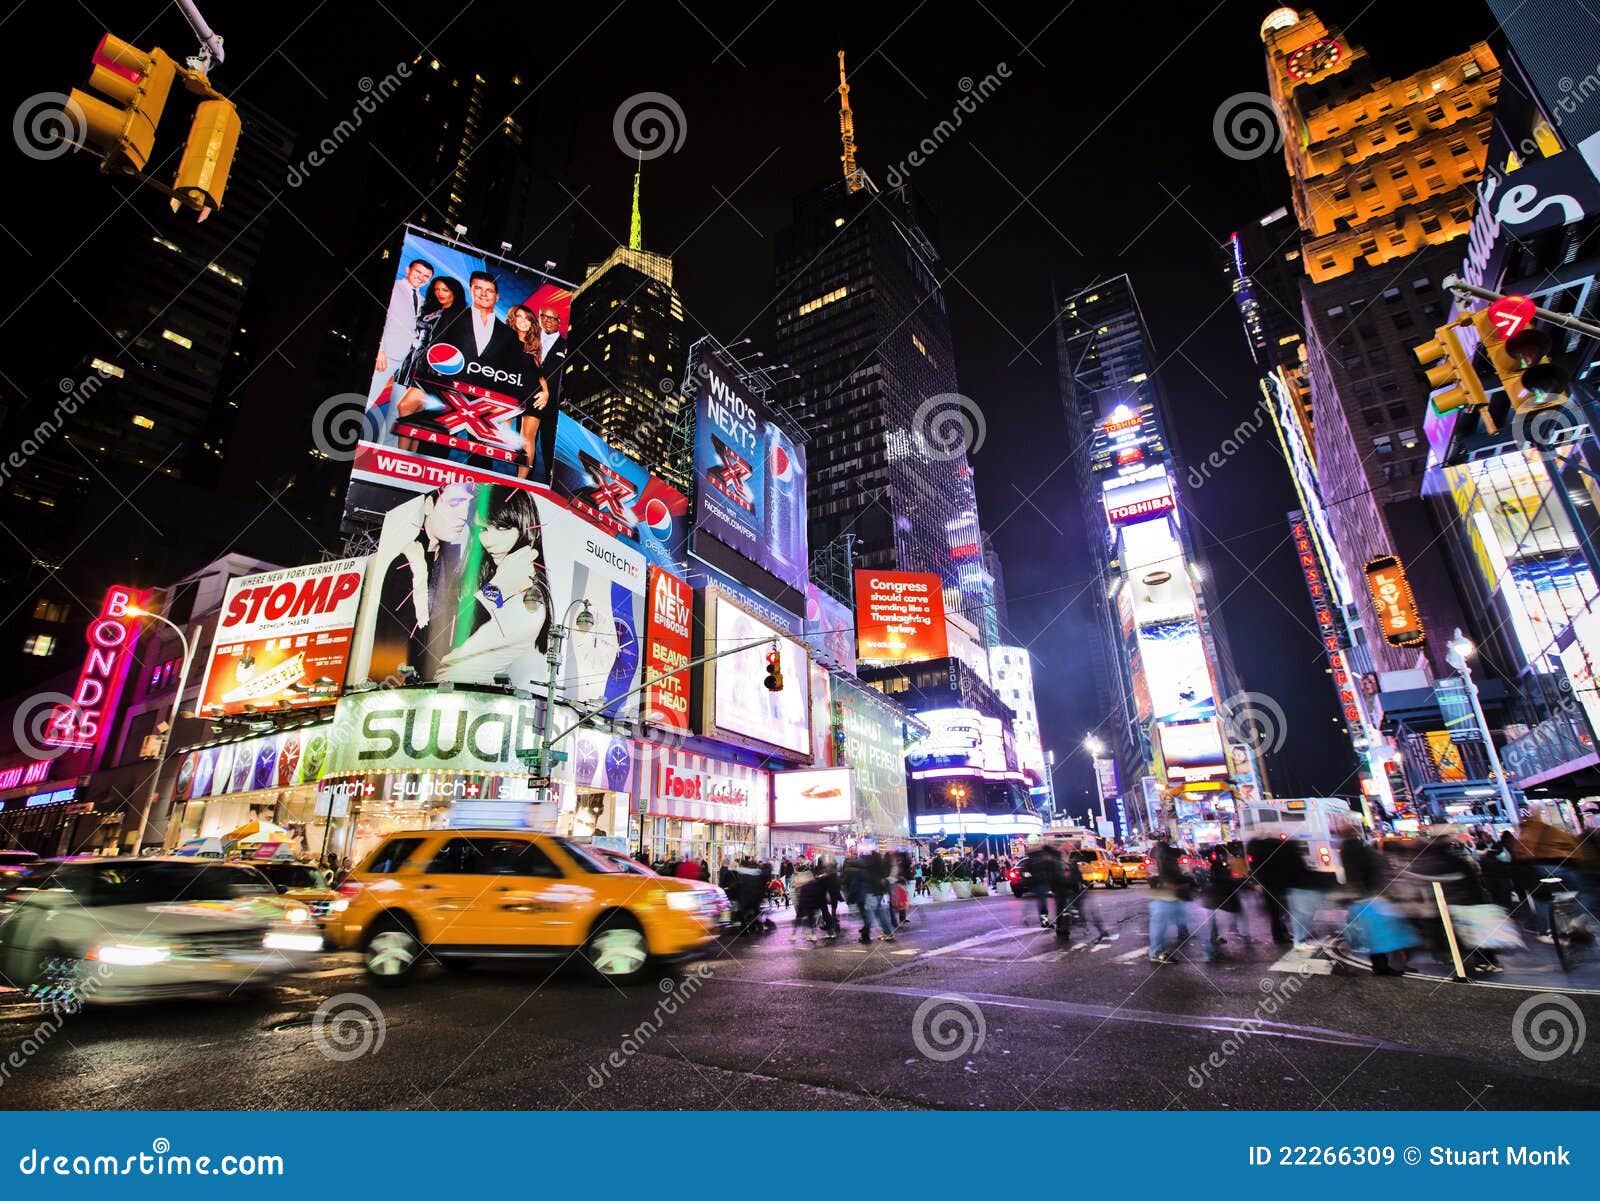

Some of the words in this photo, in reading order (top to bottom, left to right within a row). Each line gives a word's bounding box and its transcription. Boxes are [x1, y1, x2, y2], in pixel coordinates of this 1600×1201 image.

[453, 381, 491, 398] THE
[709, 369, 757, 431] WHO'S
[433, 389, 527, 450] X
[707, 395, 757, 456] NEXT?
[1105, 416, 1143, 433] TOSHIBA
[409, 429, 513, 462] FACTOR
[600, 463, 621, 481] THE
[576, 501, 633, 538] FACTOR
[1110, 496, 1173, 520] TOSHIBA
[308, 564, 333, 576] TURNS
[334, 563, 344, 572] IT
[344, 560, 355, 571] UP
[586, 539, 631, 576] swatch
[1293, 524, 1322, 597] ERNST
[222, 572, 361, 628] STOMP
[657, 573, 684, 605] ALL
[870, 578, 928, 593] Congress
[870, 592, 902, 602] should
[655, 590, 689, 626] NEW
[870, 603, 907, 613] spending
[908, 603, 923, 612] like
[870, 612, 931, 625] Thanksgiving
[654, 612, 689, 638] EPISODES
[78, 591, 129, 706] BOND
[652, 642, 688, 667] BEAVIS
[1325, 637, 1360, 721] YOUNG
[658, 689, 687, 713] HEAD
[54, 708, 100, 739] 45
[391, 780, 467, 797] swatch
[665, 767, 701, 801] Foot
